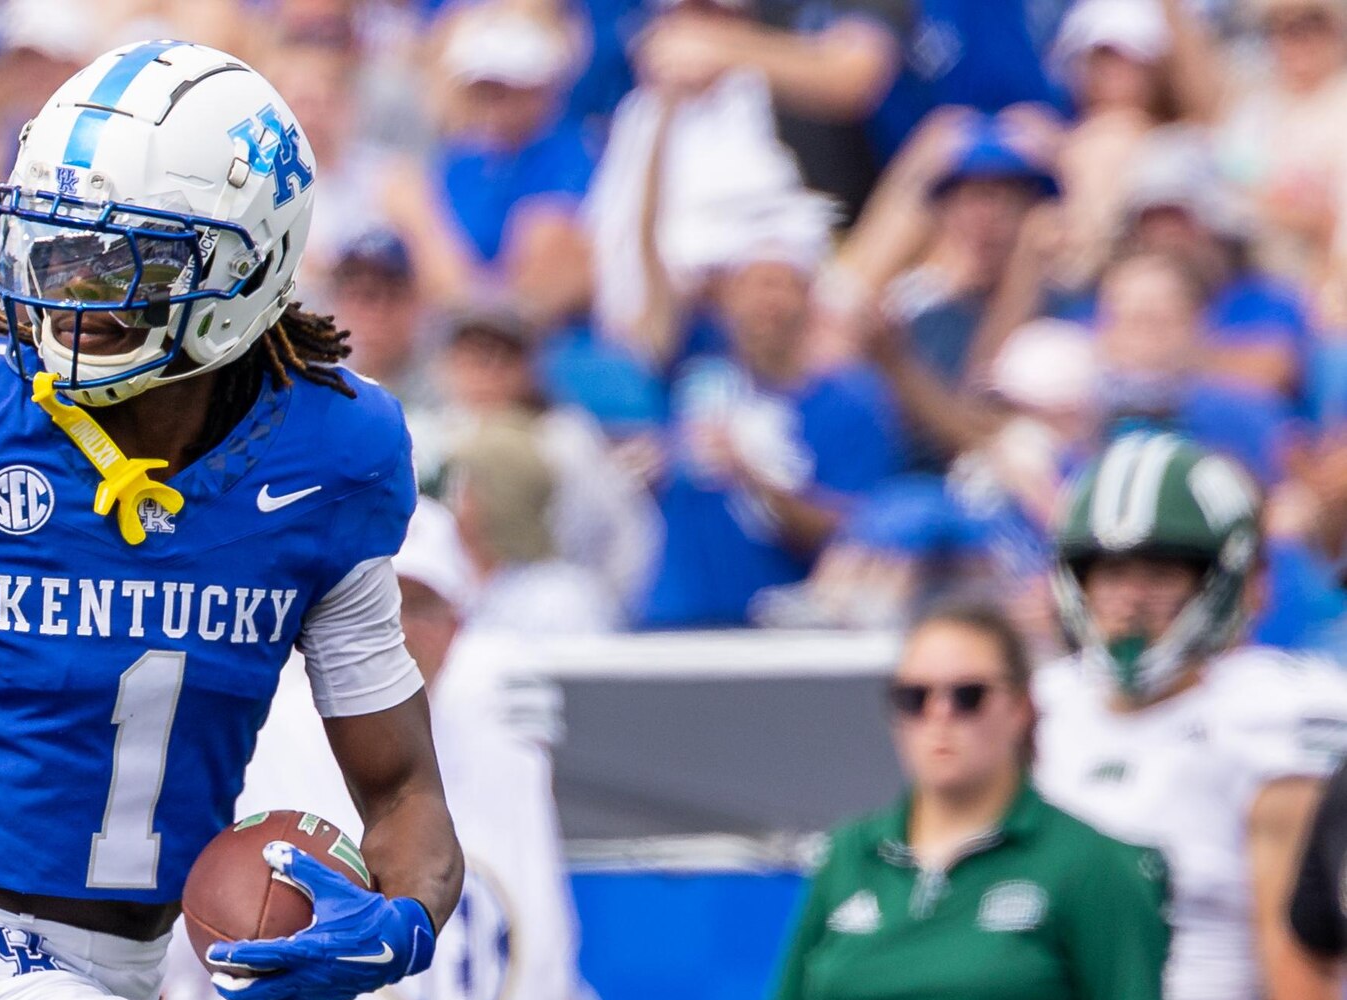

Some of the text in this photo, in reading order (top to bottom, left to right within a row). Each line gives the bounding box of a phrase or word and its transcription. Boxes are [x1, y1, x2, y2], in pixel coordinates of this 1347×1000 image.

[55, 166, 80, 194] UK
[227, 103, 315, 210] UK
[70, 419, 121, 471] NXTRND
[86, 649, 187, 889] 1
